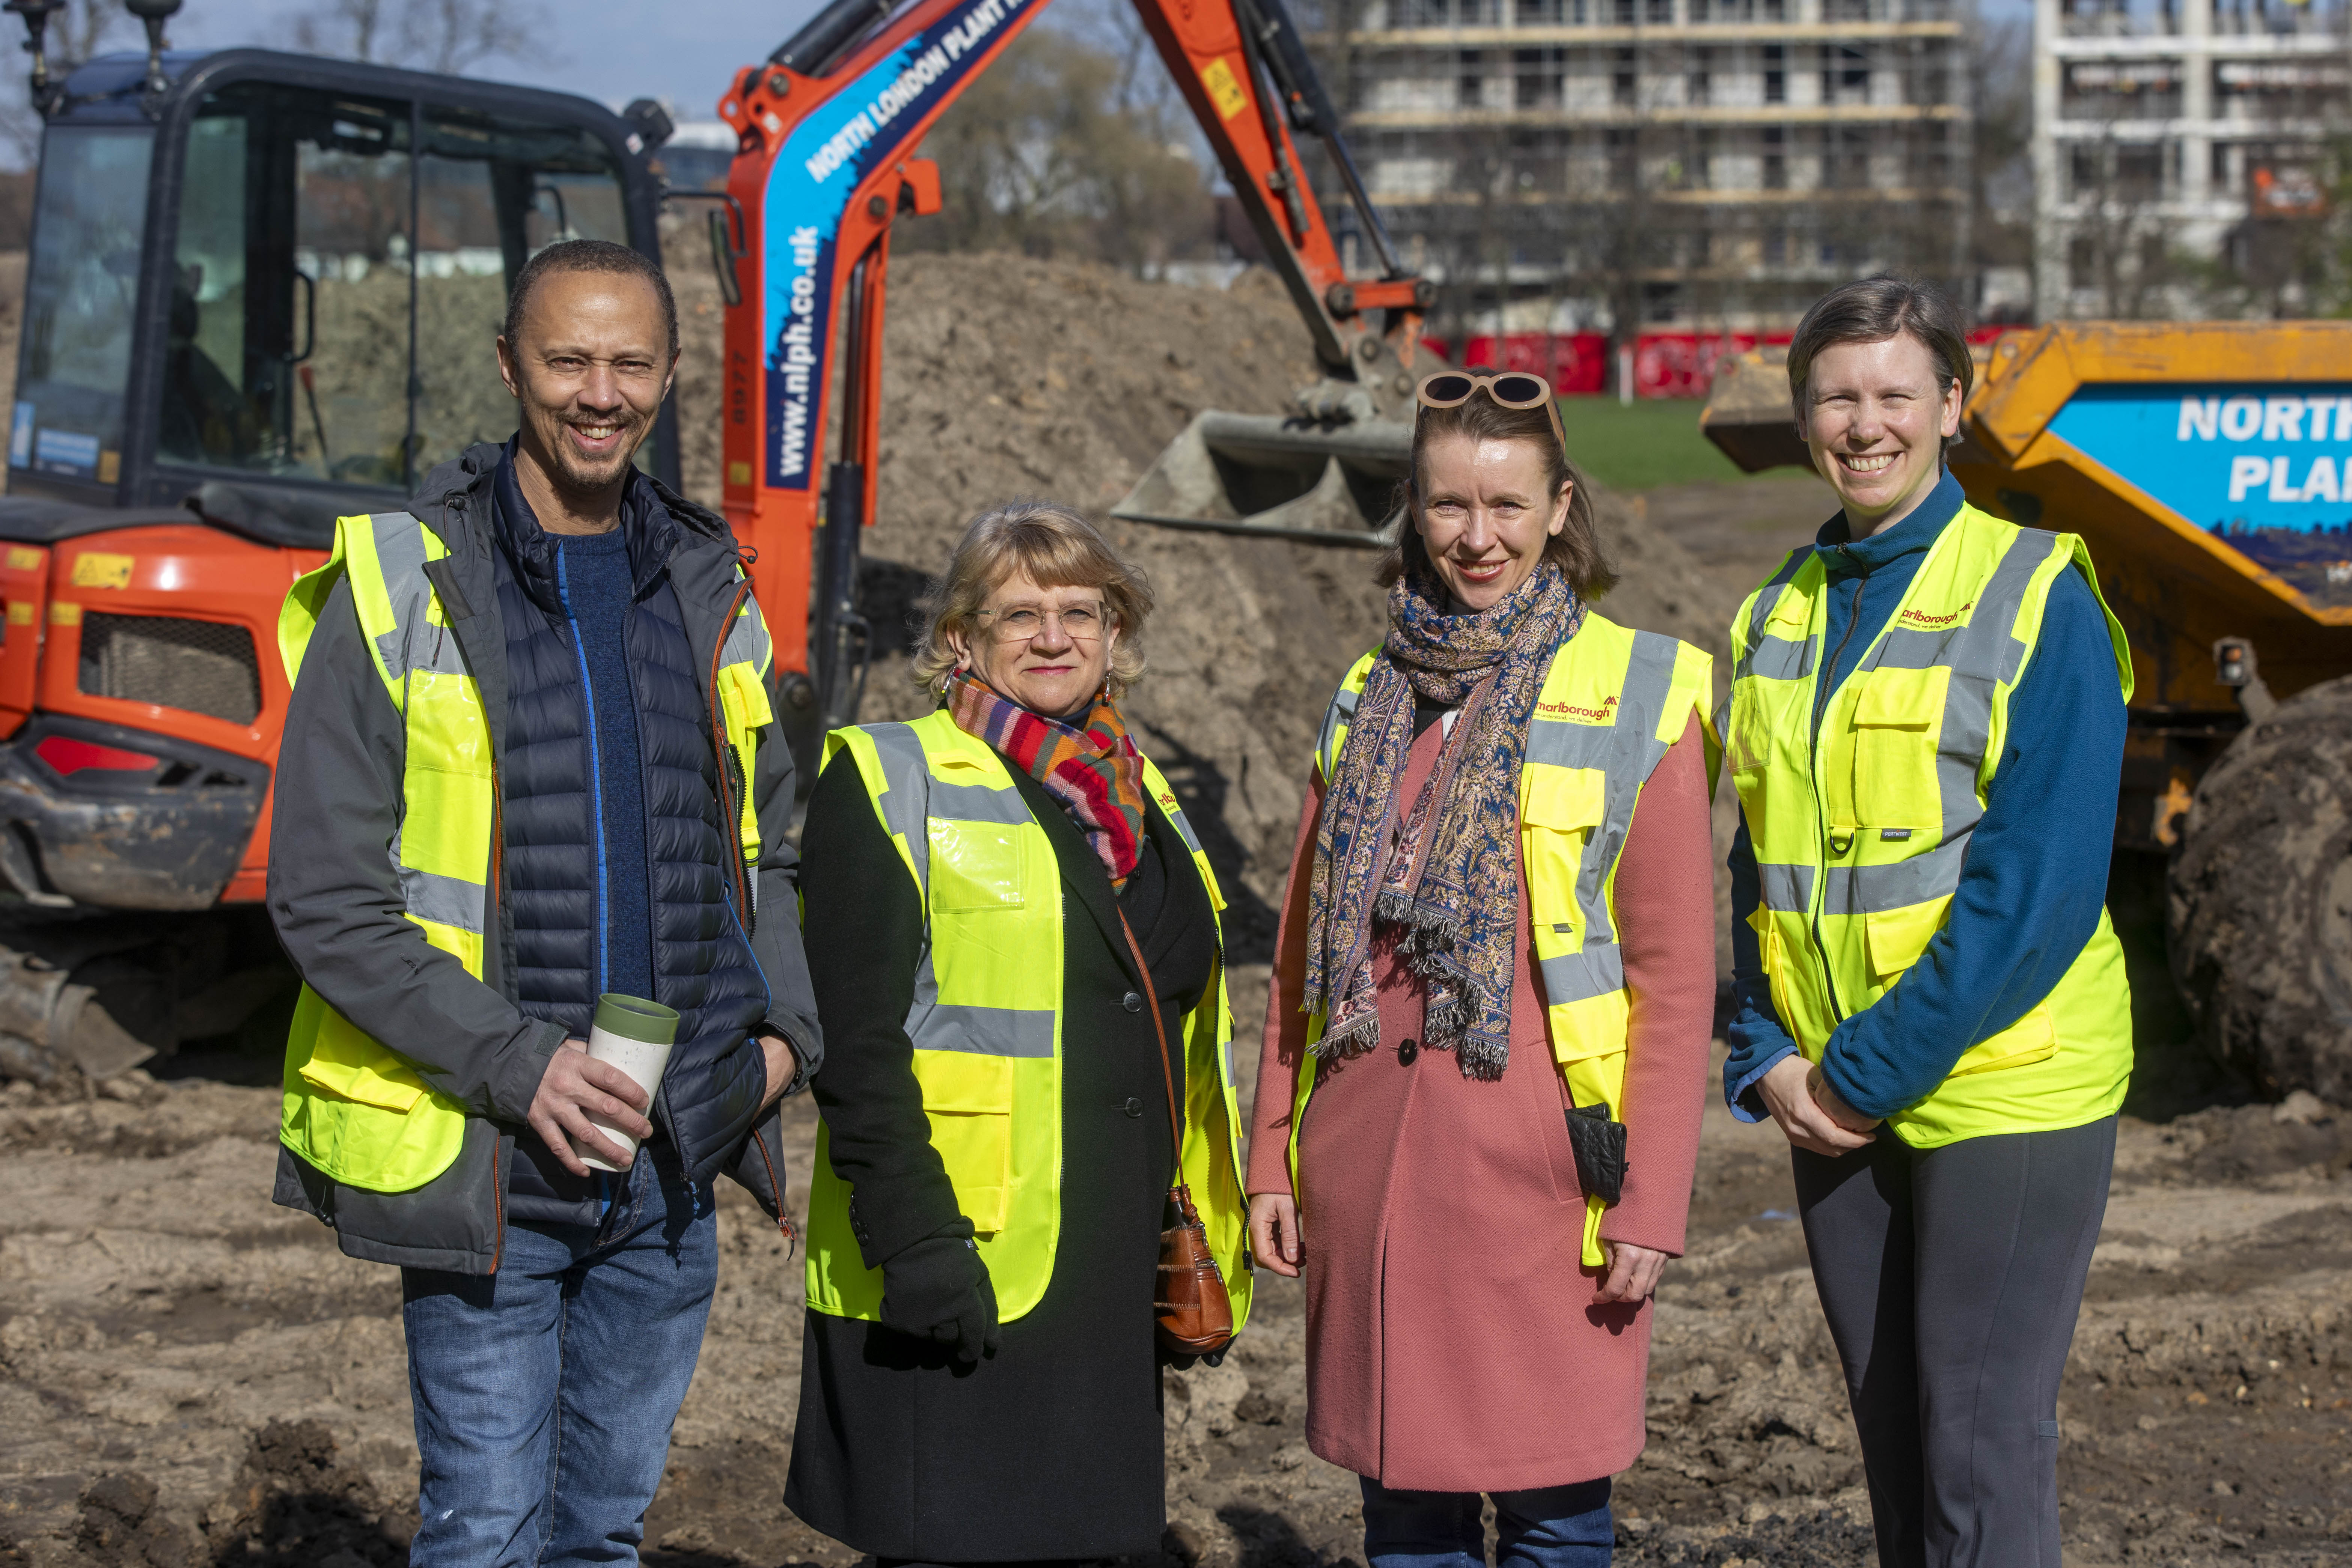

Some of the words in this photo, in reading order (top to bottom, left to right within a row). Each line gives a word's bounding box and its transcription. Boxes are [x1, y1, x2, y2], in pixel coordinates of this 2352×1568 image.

[805, 111, 877, 184] NORTH
[867, 44, 951, 127] LONDON
[940, 0, 1006, 61] PLANT
[780, 225, 818, 477] www.nlph.co.uk
[2228, 455, 2352, 502] PLA
[1902, 610, 1958, 624] arlborough
[1535, 702, 1609, 720] marlborough
